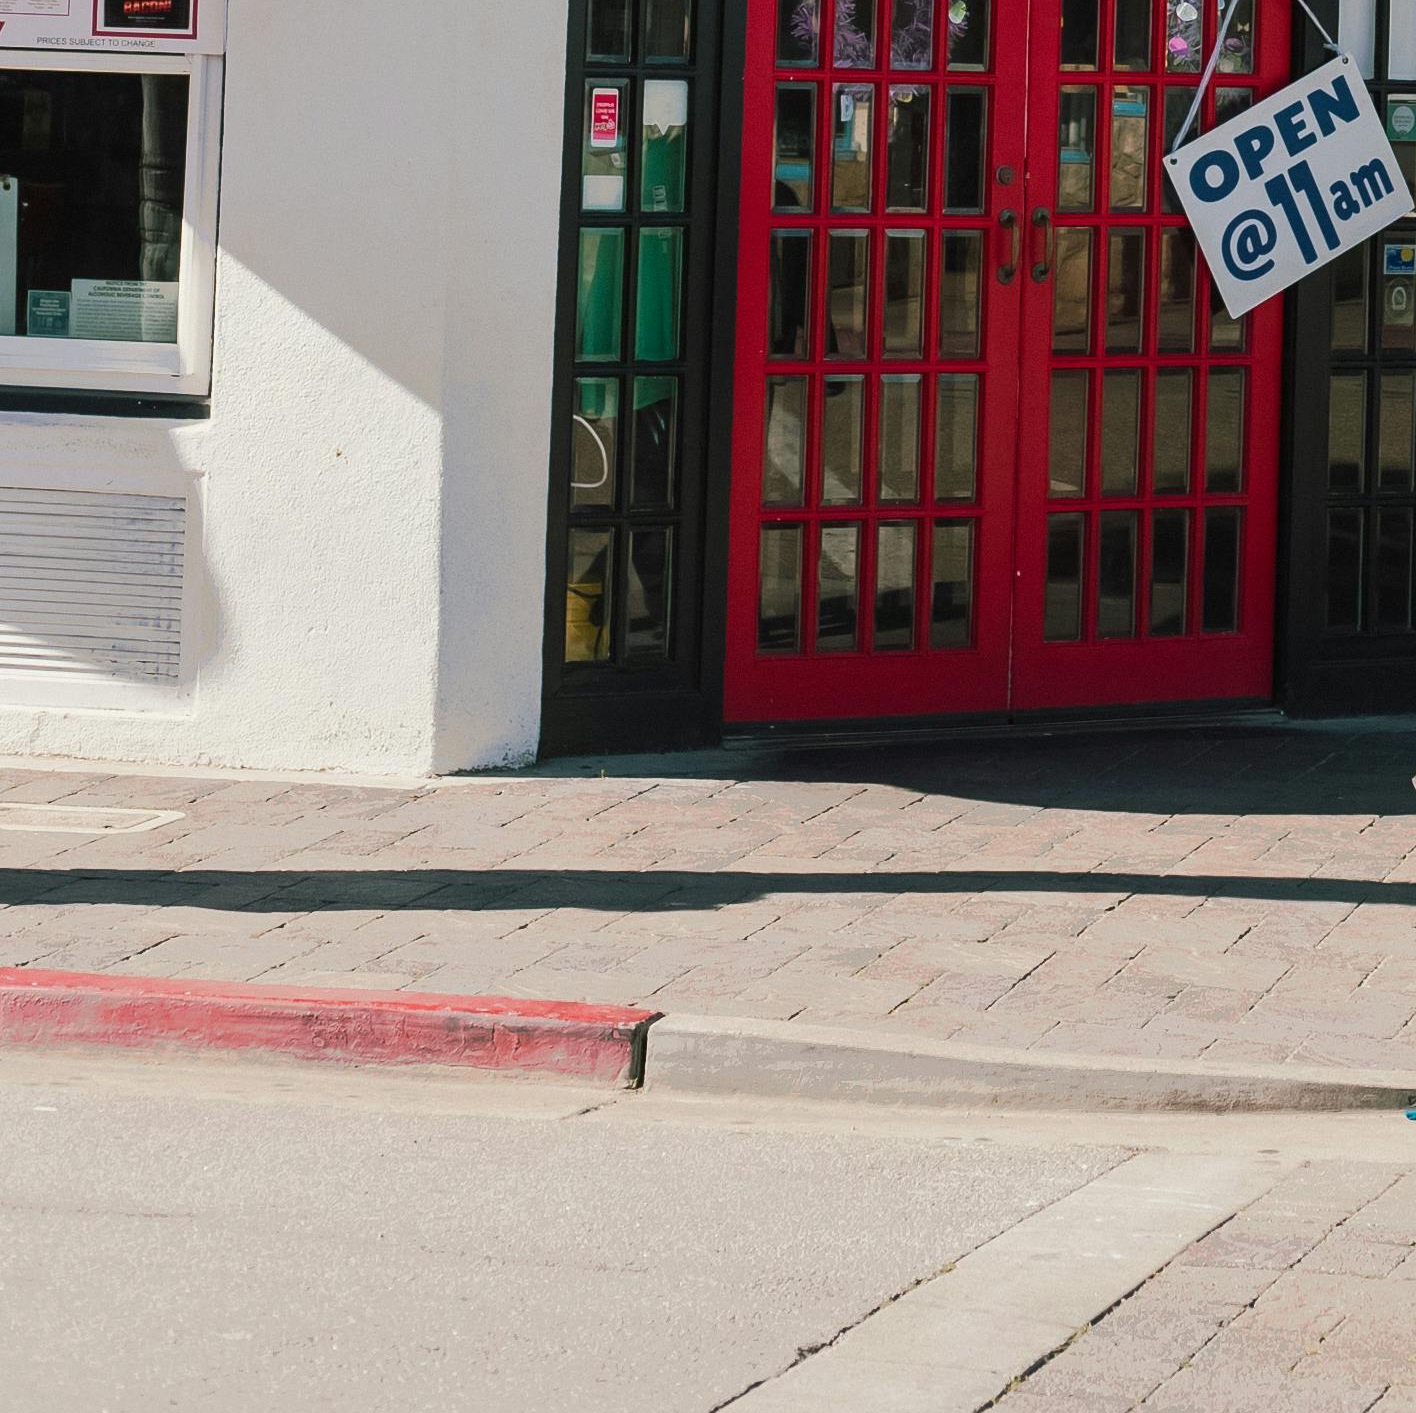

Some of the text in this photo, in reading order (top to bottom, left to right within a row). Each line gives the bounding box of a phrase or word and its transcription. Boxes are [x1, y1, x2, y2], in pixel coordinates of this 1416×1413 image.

[36, 36, 156, 48] PRICES SUBJECT TO CHANGE
[1188, 74, 1361, 203] OPEN
